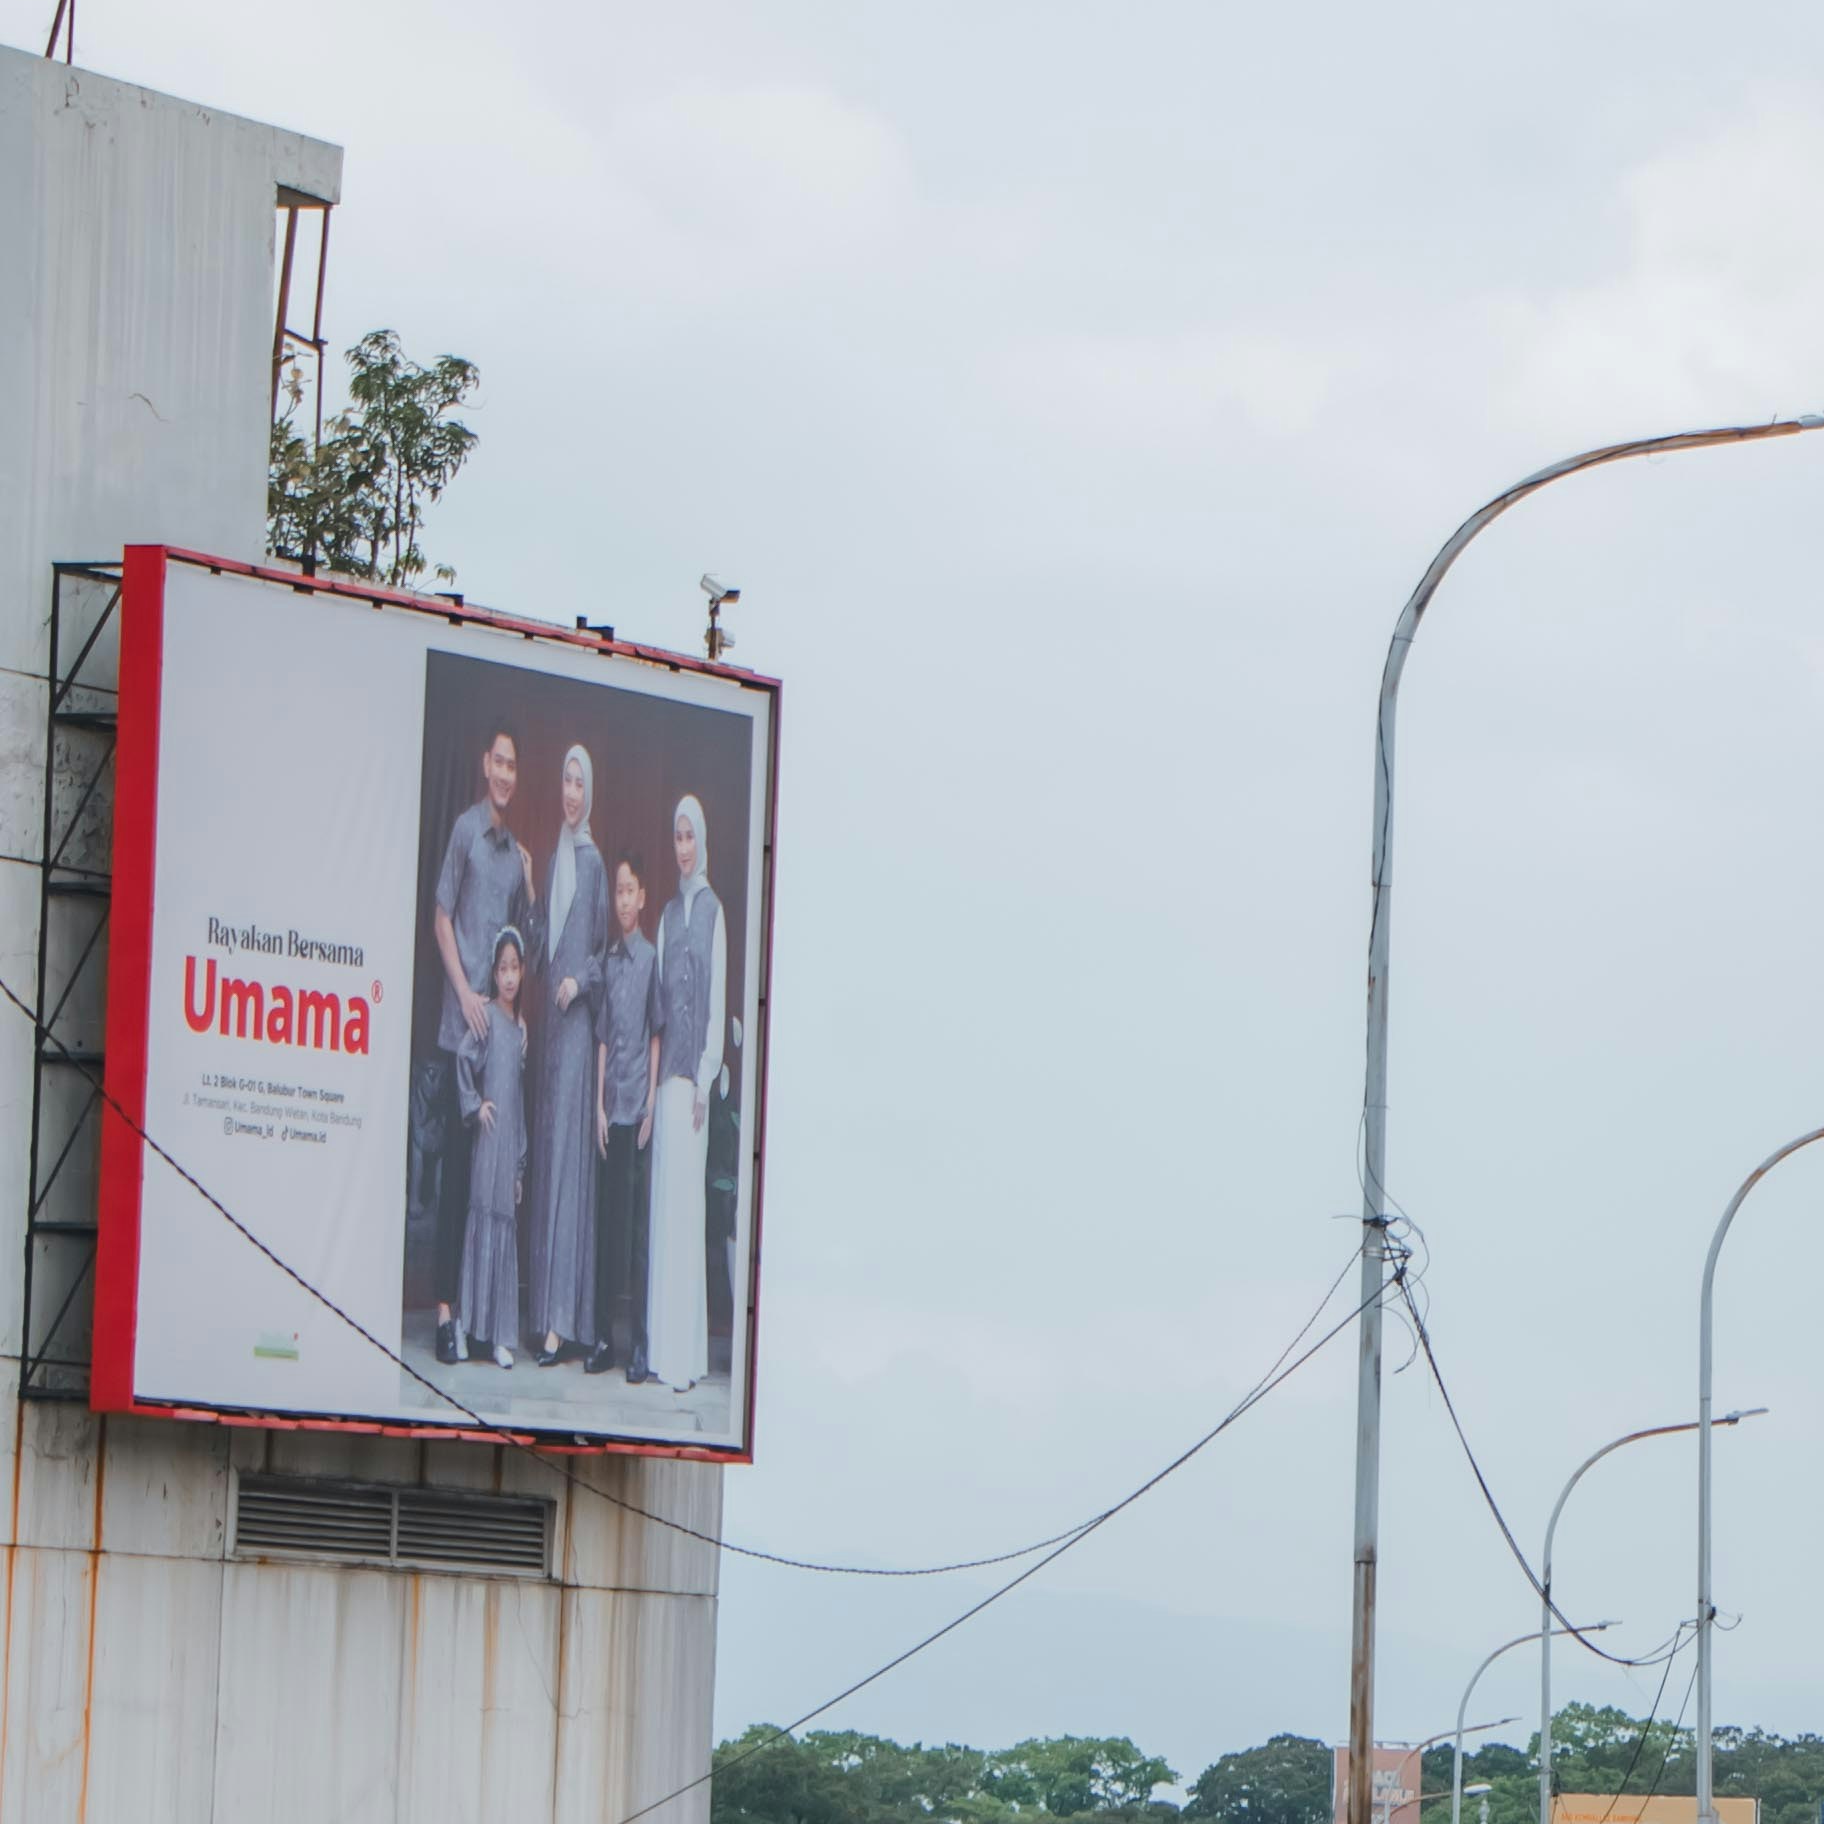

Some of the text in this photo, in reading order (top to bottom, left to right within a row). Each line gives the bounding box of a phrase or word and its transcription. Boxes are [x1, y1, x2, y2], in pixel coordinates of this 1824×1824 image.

[207, 916, 365, 968] Rayakan Bersama
[220, 1076, 237, 1089] Blok
[298, 1086, 318, 1100] Town
[320, 1089, 345, 1105] Square
